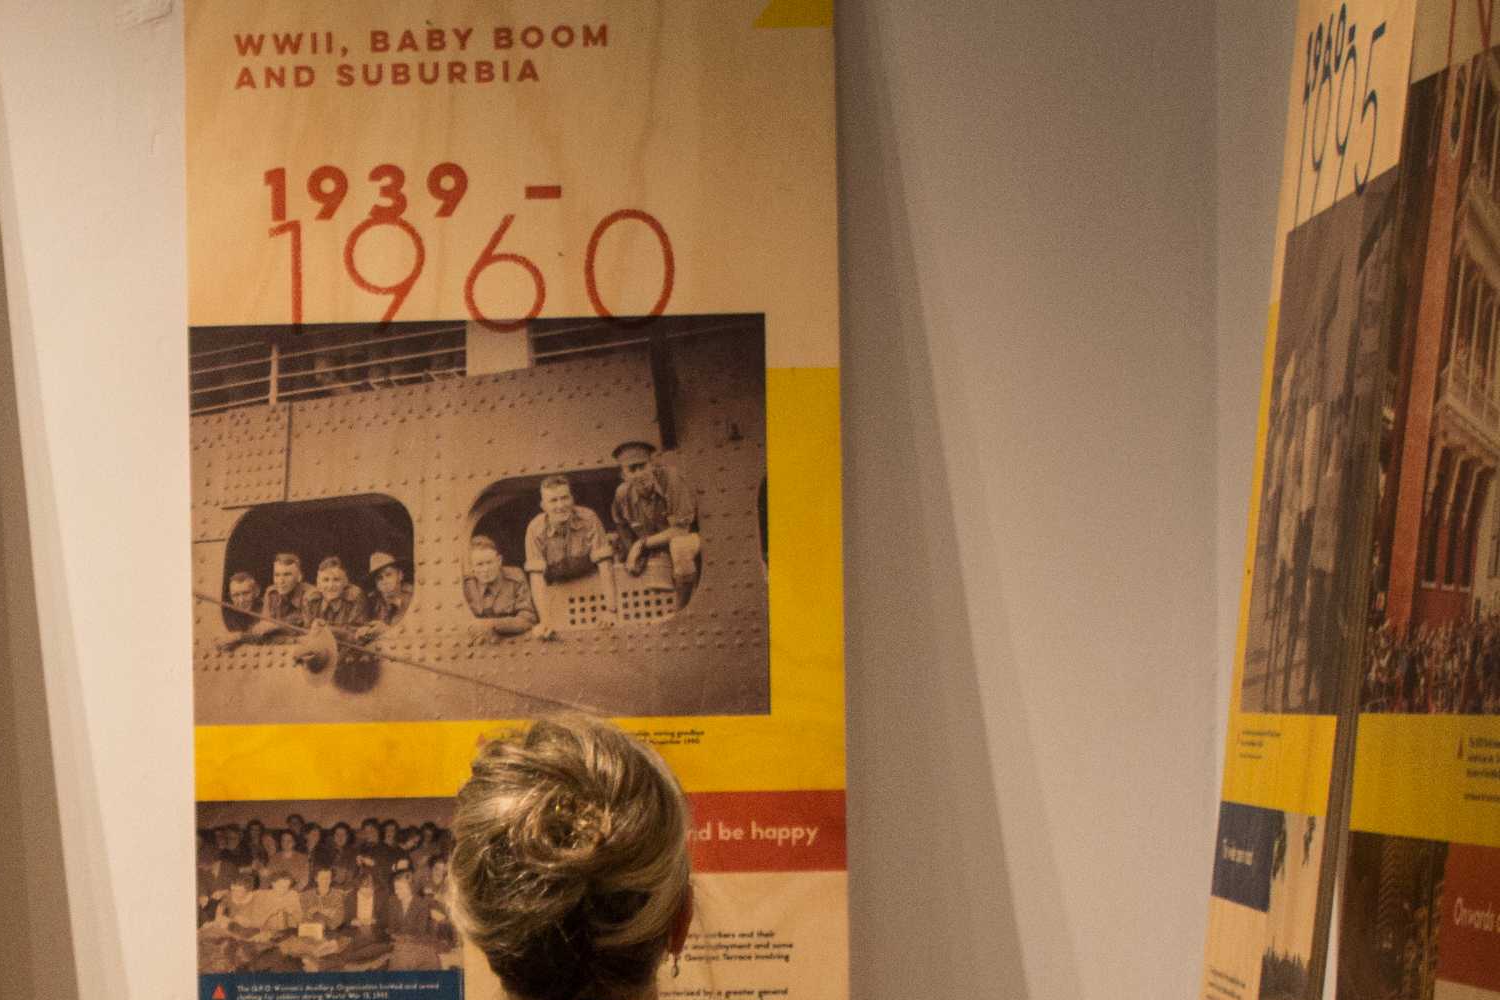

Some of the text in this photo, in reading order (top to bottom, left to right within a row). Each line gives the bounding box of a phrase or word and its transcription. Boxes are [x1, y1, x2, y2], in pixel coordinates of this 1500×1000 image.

[233, 23, 608, 57] WWII, BABY BOOM
[234, 58, 540, 90] AND SUBURBIA
[263, 161, 469, 221] 1939
[268, 207, 674, 334] 1960
[686, 820, 819, 847] nd be happy
